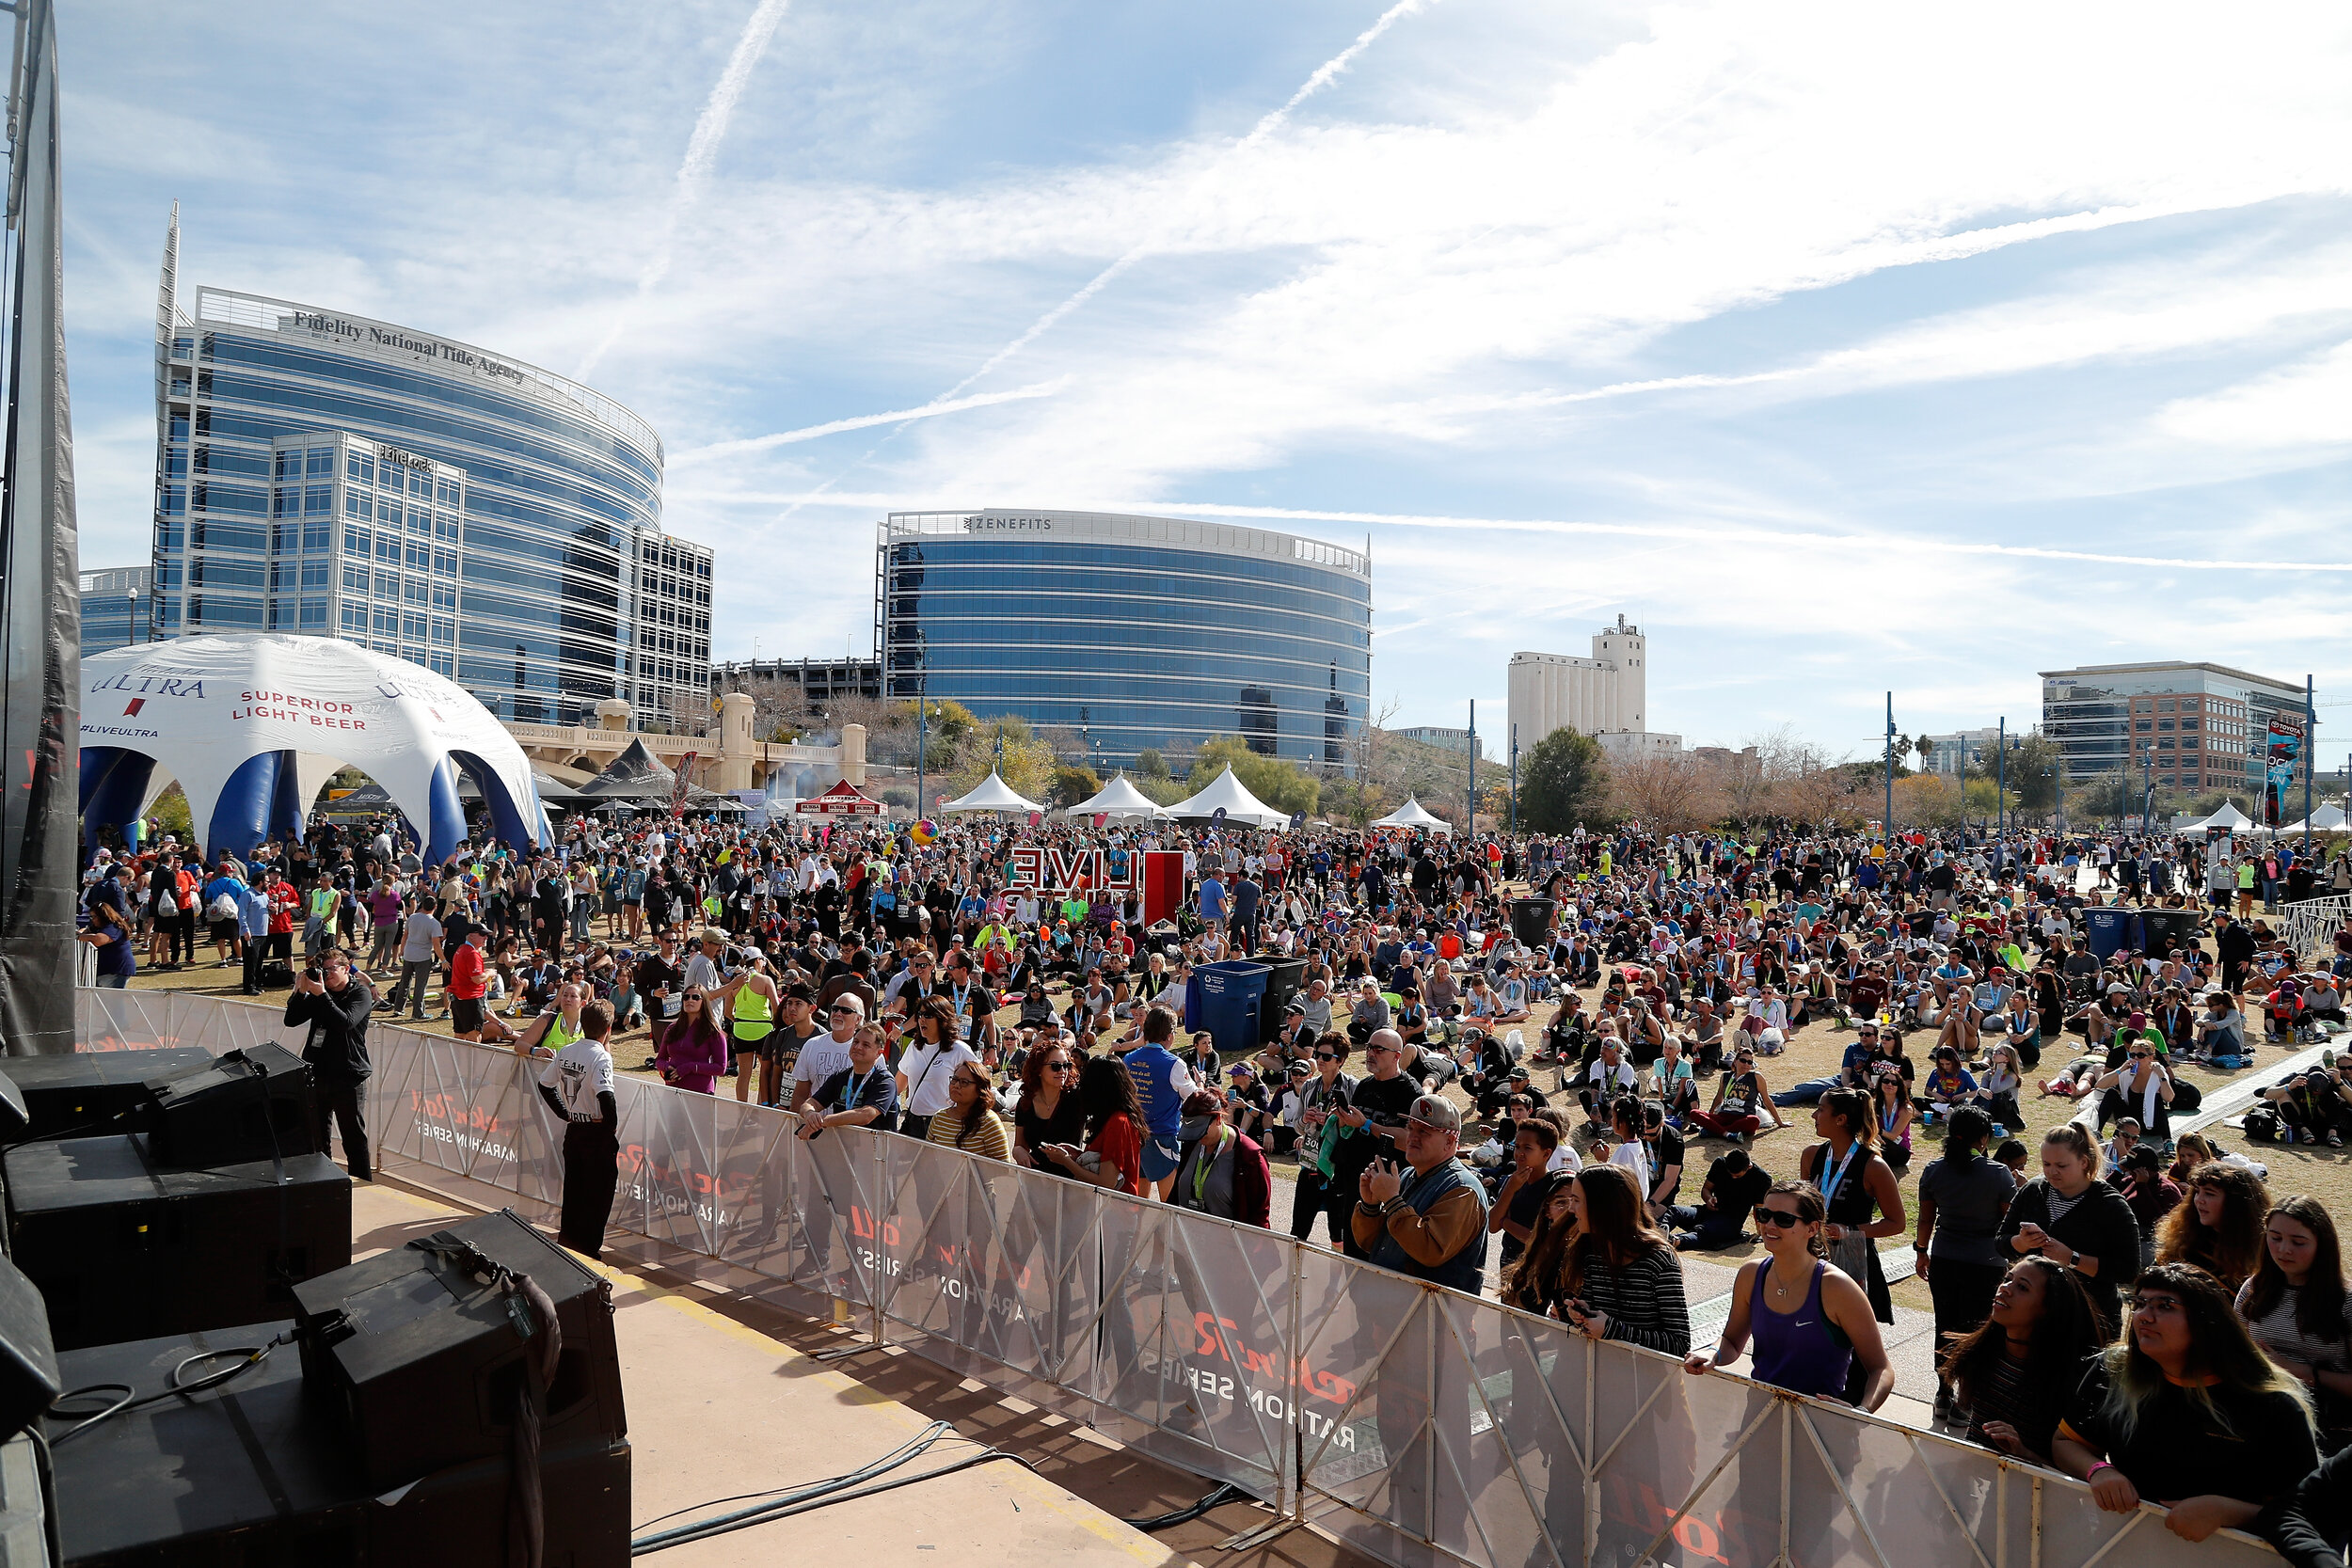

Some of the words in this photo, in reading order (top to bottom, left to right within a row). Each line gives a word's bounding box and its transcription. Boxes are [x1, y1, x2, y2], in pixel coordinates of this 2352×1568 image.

[294, 310, 363, 341] Fidelity
[369, 326, 437, 356] National
[440, 344, 474, 366] Title
[477, 356, 525, 385] Agency
[976, 518, 1052, 531] ZENEFITS
[241, 690, 354, 715] SUPERIOR
[232, 706, 299, 723] LIGHT
[310, 715, 367, 731] BEER
[80, 724, 159, 738] #LIVEULTRA
[2279, 723, 2301, 735] TOYOTA
[2267, 755, 2294, 770] OCK
[2267, 765, 2287, 775] OUR
[2267, 774, 2287, 785] UN
[782, 1051, 800, 1059] ARIZ
